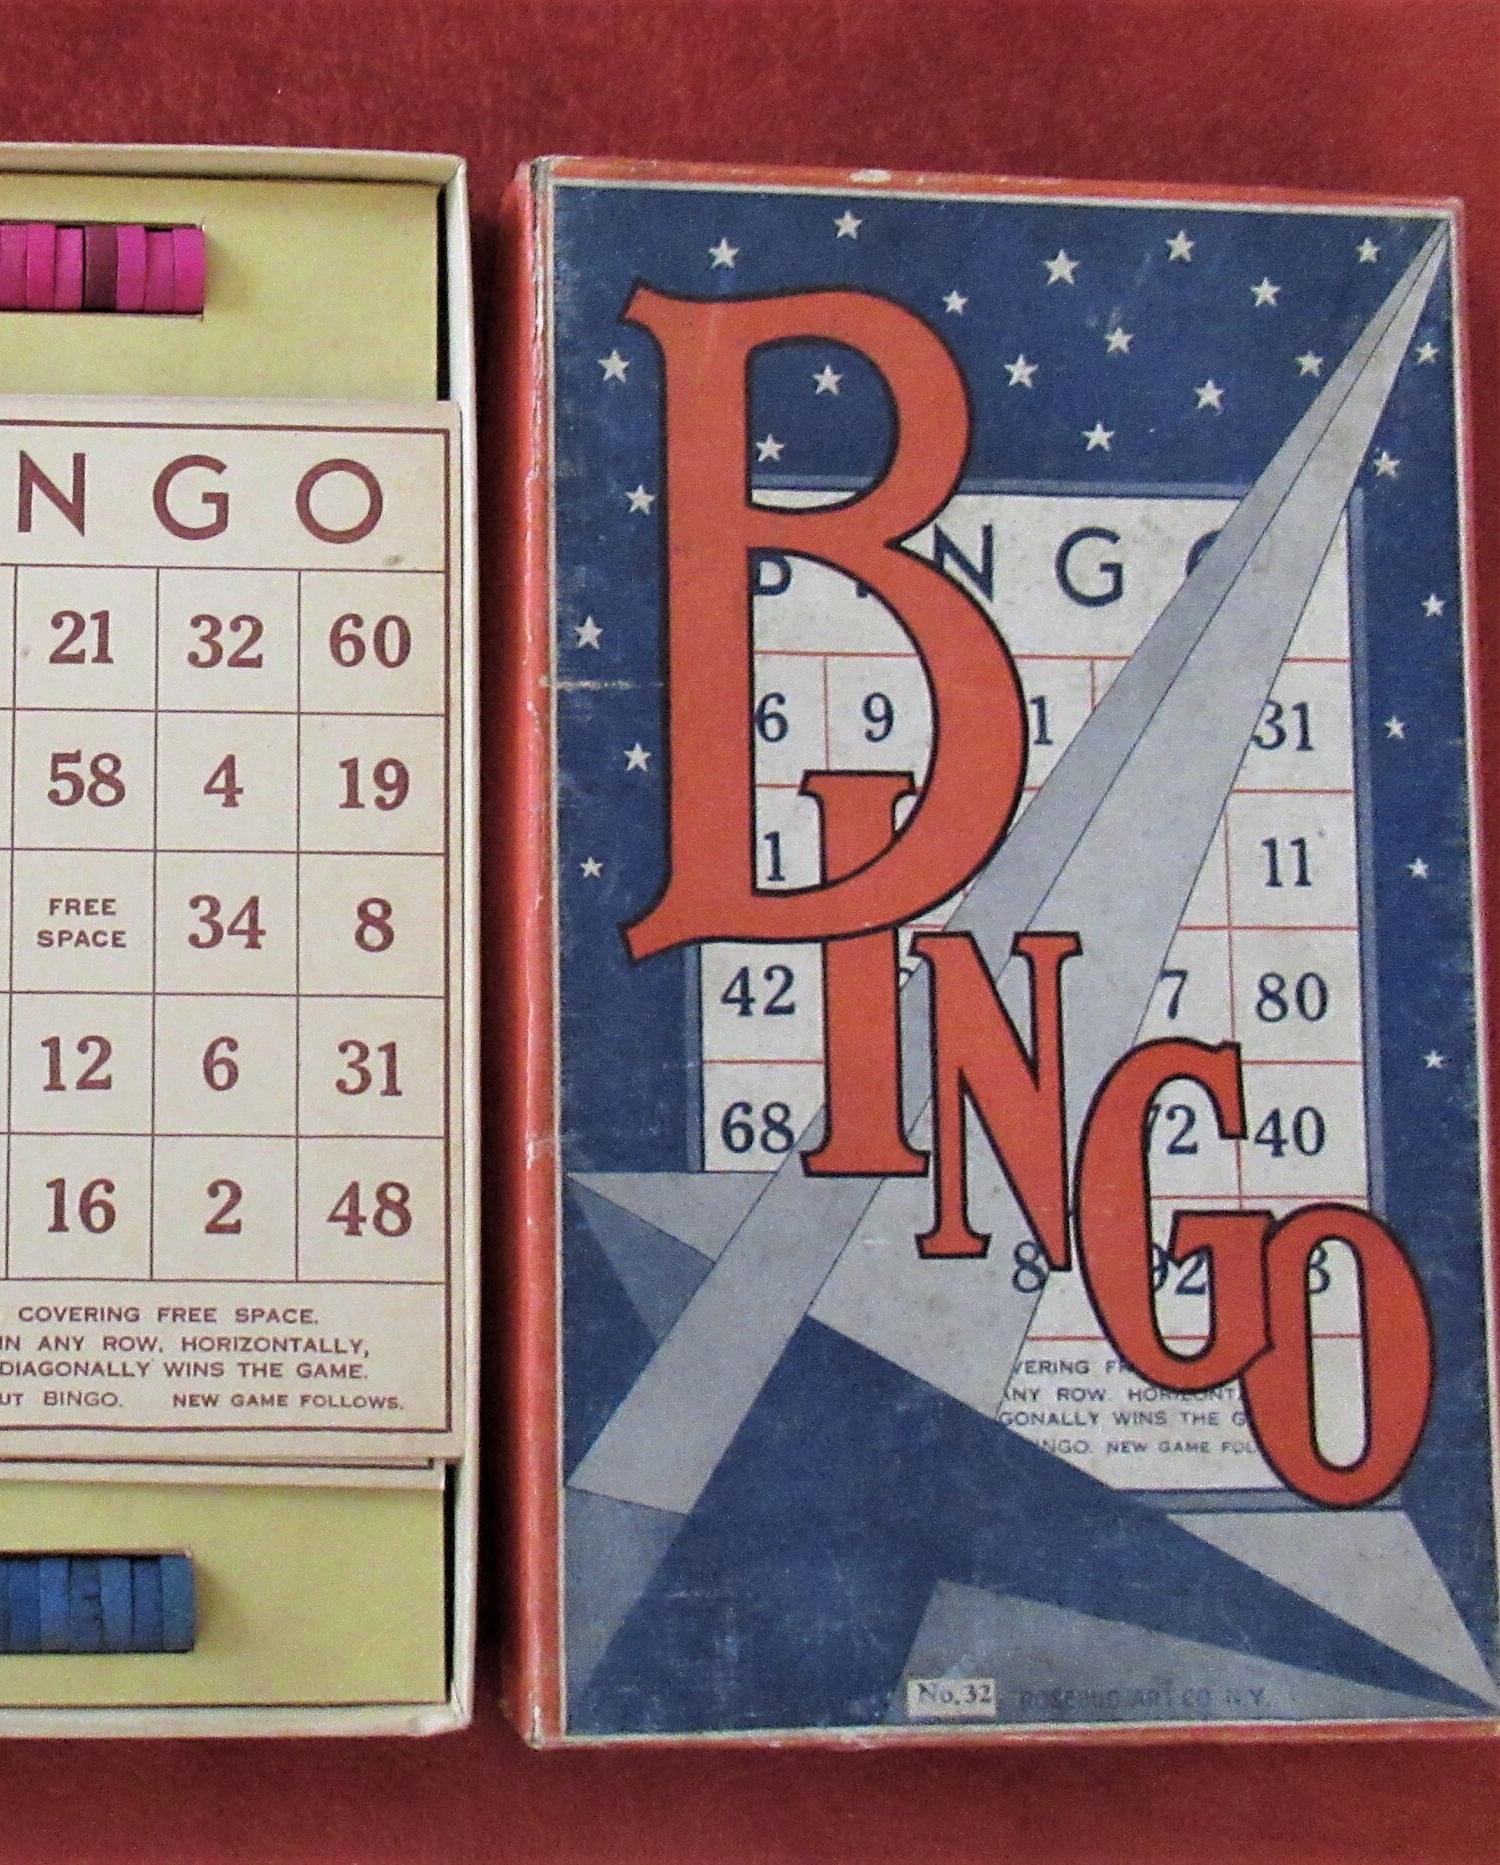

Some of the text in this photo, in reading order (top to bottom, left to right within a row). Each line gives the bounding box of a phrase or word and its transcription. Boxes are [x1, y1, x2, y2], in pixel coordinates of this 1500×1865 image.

[50, 610, 113, 664] 21
[188, 614, 263, 668] 32
[330, 613, 411, 668] 60
[863, 693, 894, 743] 9
[1251, 698, 1317, 753] 31
[48, 750, 125, 807] 58
[204, 754, 243, 807] 4
[340, 758, 409, 811] 19
[1262, 838, 1311, 887] 11
[49, 898, 116, 916] FREE
[188, 895, 266, 949] 34
[355, 898, 394, 952] 8
[37, 930, 126, 948] SPACE
[721, 965, 795, 1016] 42
[1256, 972, 1328, 1022] 80
[41, 1035, 112, 1091] 12
[203, 1037, 238, 1091] 6
[336, 1040, 402, 1096] 31
[720, 1102, 796, 1155] 68
[1254, 1106, 1325, 1157] 40
[46, 1178, 115, 1234] 16
[205, 1179, 242, 1234] 2
[327, 1181, 412, 1237] 48
[18, 1306, 140, 1323] COVERING
[158, 1307, 216, 1323] FREE
[235, 1308, 318, 1324] SPACE.
[0, 1336, 20, 1351] IN
[38, 1336, 84, 1351] ANY
[182, 1336, 369, 1358] HORIZONTALLY,
[0, 1361, 150, 1377] DIAGONALLY
[164, 1362, 224, 1377] WINS
[237, 1362, 283, 1378] THE
[296, 1363, 367, 1379] GAME.
[44, 1391, 123, 1408] BINGO.
[173, 1394, 219, 1407] NEW
[231, 1394, 288, 1407] GAME
[300, 1394, 404, 1410] FOLLOWS.
[1112, 1411, 1168, 1426] WINS
[1181, 1412, 1220, 1426] THE
[1106, 1441, 1148, 1454] NEW
[1157, 1441, 1210, 1454] GAME
